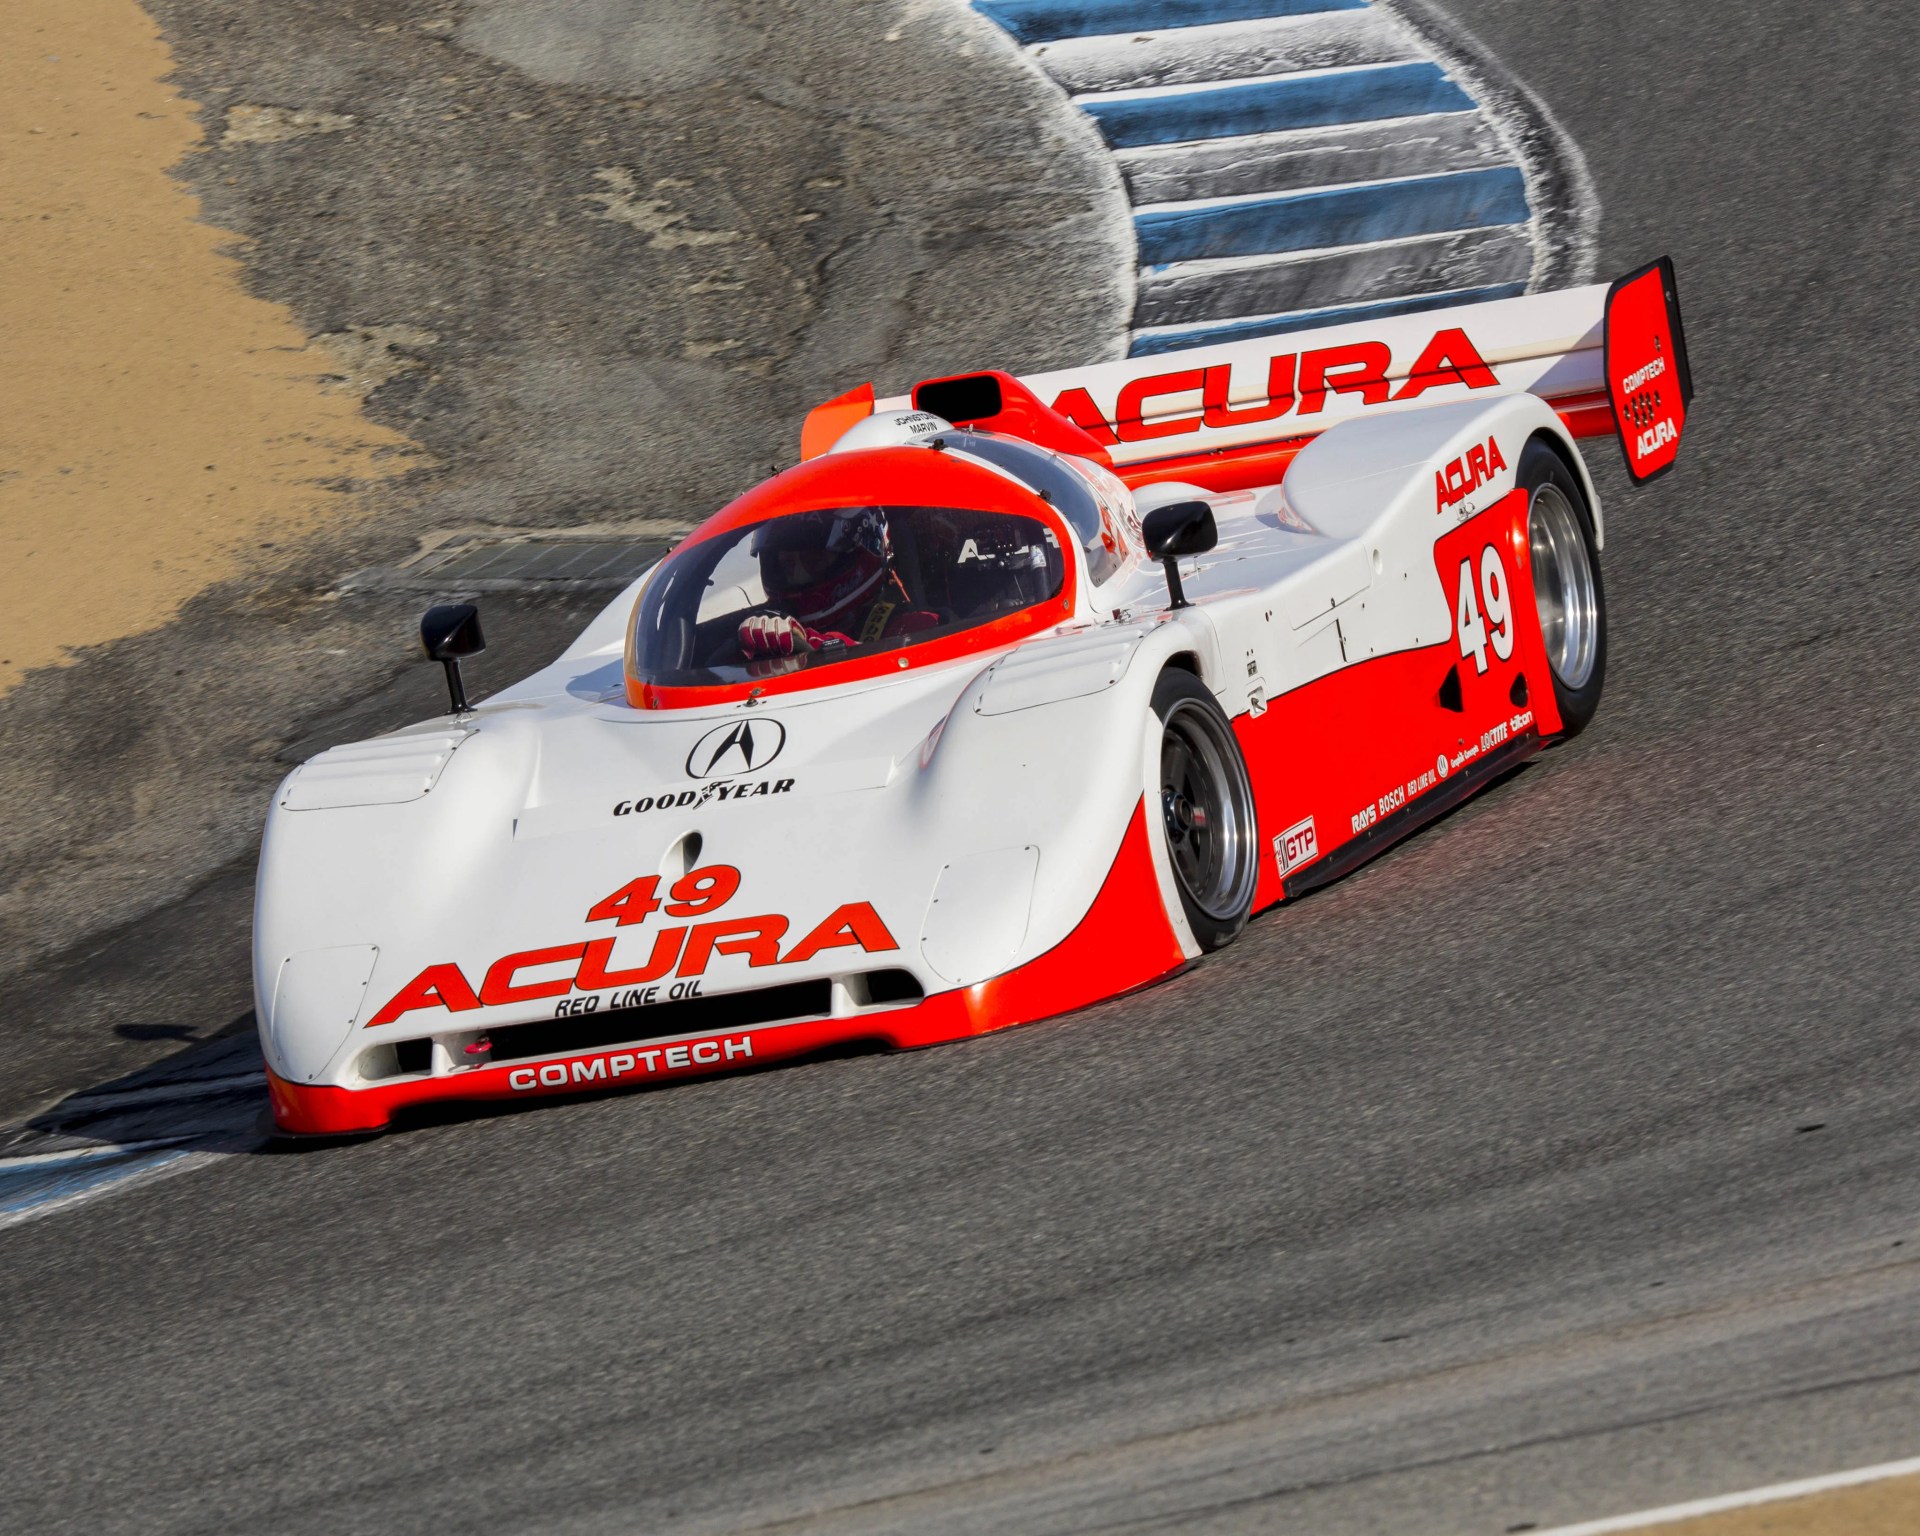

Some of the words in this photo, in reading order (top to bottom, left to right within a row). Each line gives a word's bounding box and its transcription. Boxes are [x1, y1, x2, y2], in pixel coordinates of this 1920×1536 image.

[1051, 327, 1500, 446] ACURA
[1623, 357, 1665, 394] COMPTECH
[909, 422, 938, 434] MARVIN
[1637, 417, 1678, 459] ACURA
[1436, 435, 1507, 515] ACURA
[1457, 542, 1514, 677] 49
[1480, 721, 1508, 752] LOCTITE
[1378, 784, 1405, 816] BOSCH
[1407, 779, 1418, 797] RED
[1416, 772, 1428, 791] LINE
[1351, 803, 1377, 834] RAYS
[1286, 826, 1314, 862] GTP
[585, 864, 741, 927] 49
[363, 901, 900, 1028] ACURA
[554, 995, 600, 1018] RED
[610, 985, 660, 1010] LINE
[668, 979, 703, 1000] OIL
[508, 1036, 754, 1091] COMPTECH
